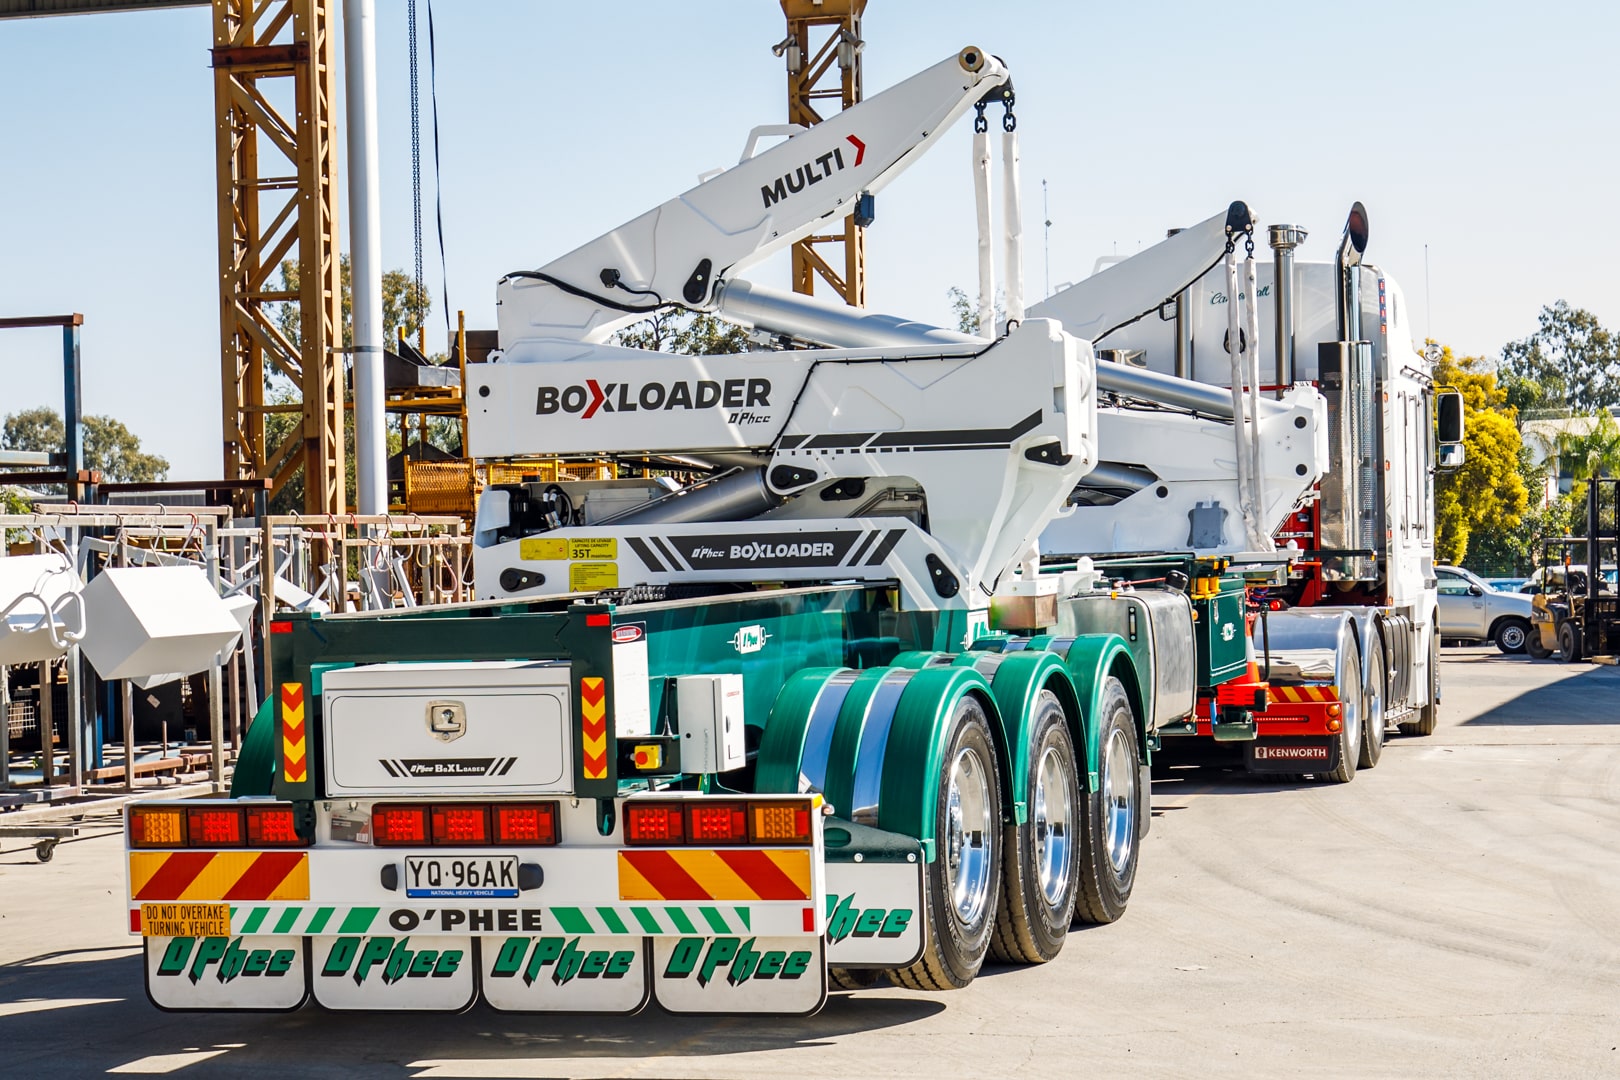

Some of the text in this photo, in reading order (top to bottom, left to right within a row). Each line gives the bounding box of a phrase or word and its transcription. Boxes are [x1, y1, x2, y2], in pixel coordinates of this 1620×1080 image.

[761, 147, 845, 208] MULTI
[536, 378, 771, 419] BOXLOADER
[572, 549, 591, 558] 35T
[730, 542, 834, 560] BOXLOADER
[1268, 748, 1326, 757] KENWORTH
[146, 906, 224, 920] DO NOT OVERTAKE
[148, 921, 224, 936] TURNING VEHICLE
[389, 909, 542, 932] O'PHEE
[157, 936, 295, 986] OPhee
[320, 936, 463, 987] OPhee
[490, 936, 635, 988] OPhee
[662, 936, 812, 989] OPhee
